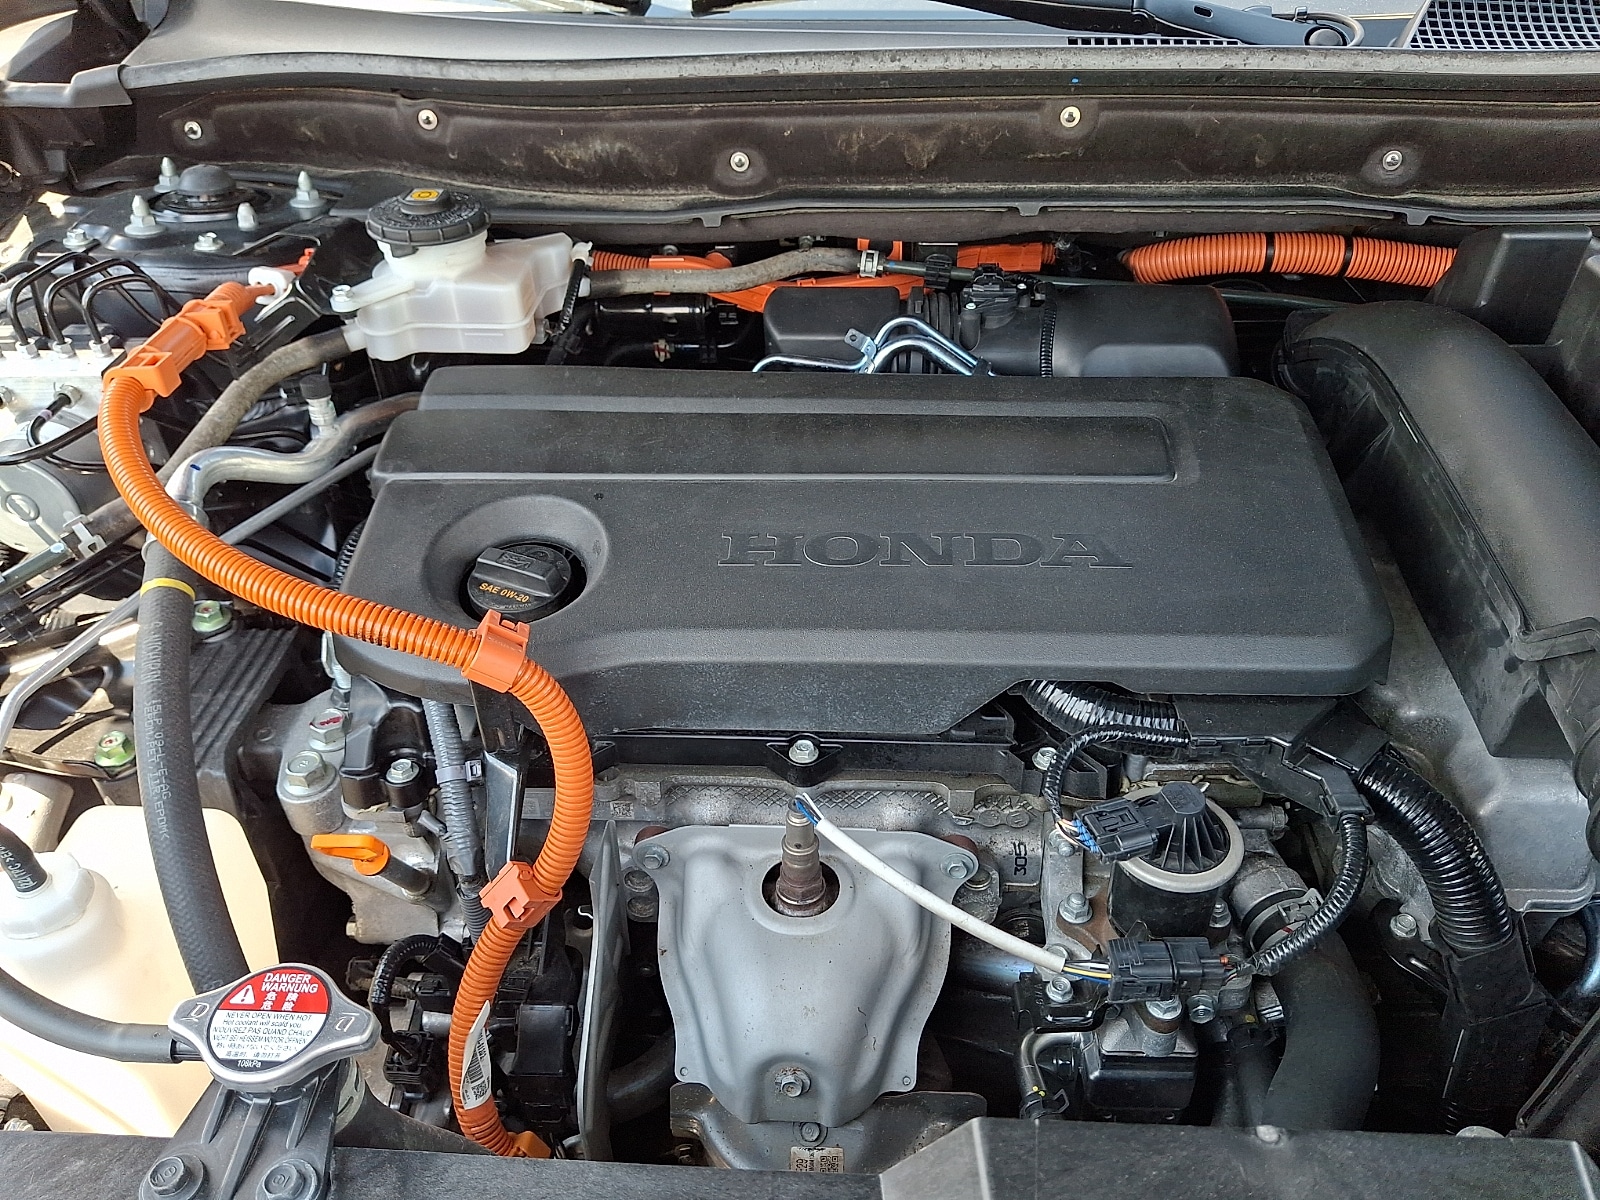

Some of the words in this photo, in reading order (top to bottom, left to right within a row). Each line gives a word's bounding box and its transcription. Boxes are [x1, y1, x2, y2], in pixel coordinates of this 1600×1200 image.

[717, 531, 1133, 569] HONDA
[479, 582, 500, 594] SAE
[500, 589, 530, 603] 0W-20
[1012, 841, 1028, 876] 305
[264, 973, 312, 984] DANGER
[261, 982, 318, 993] WARNUNG
[225, 1011, 250, 1019] NEVER
[251, 1012, 272, 1020] OPEN
[273, 1013, 295, 1021] WHEN
[295, 1014, 313, 1022] HOT
[237, 1059, 262, 1068] 108kPa
